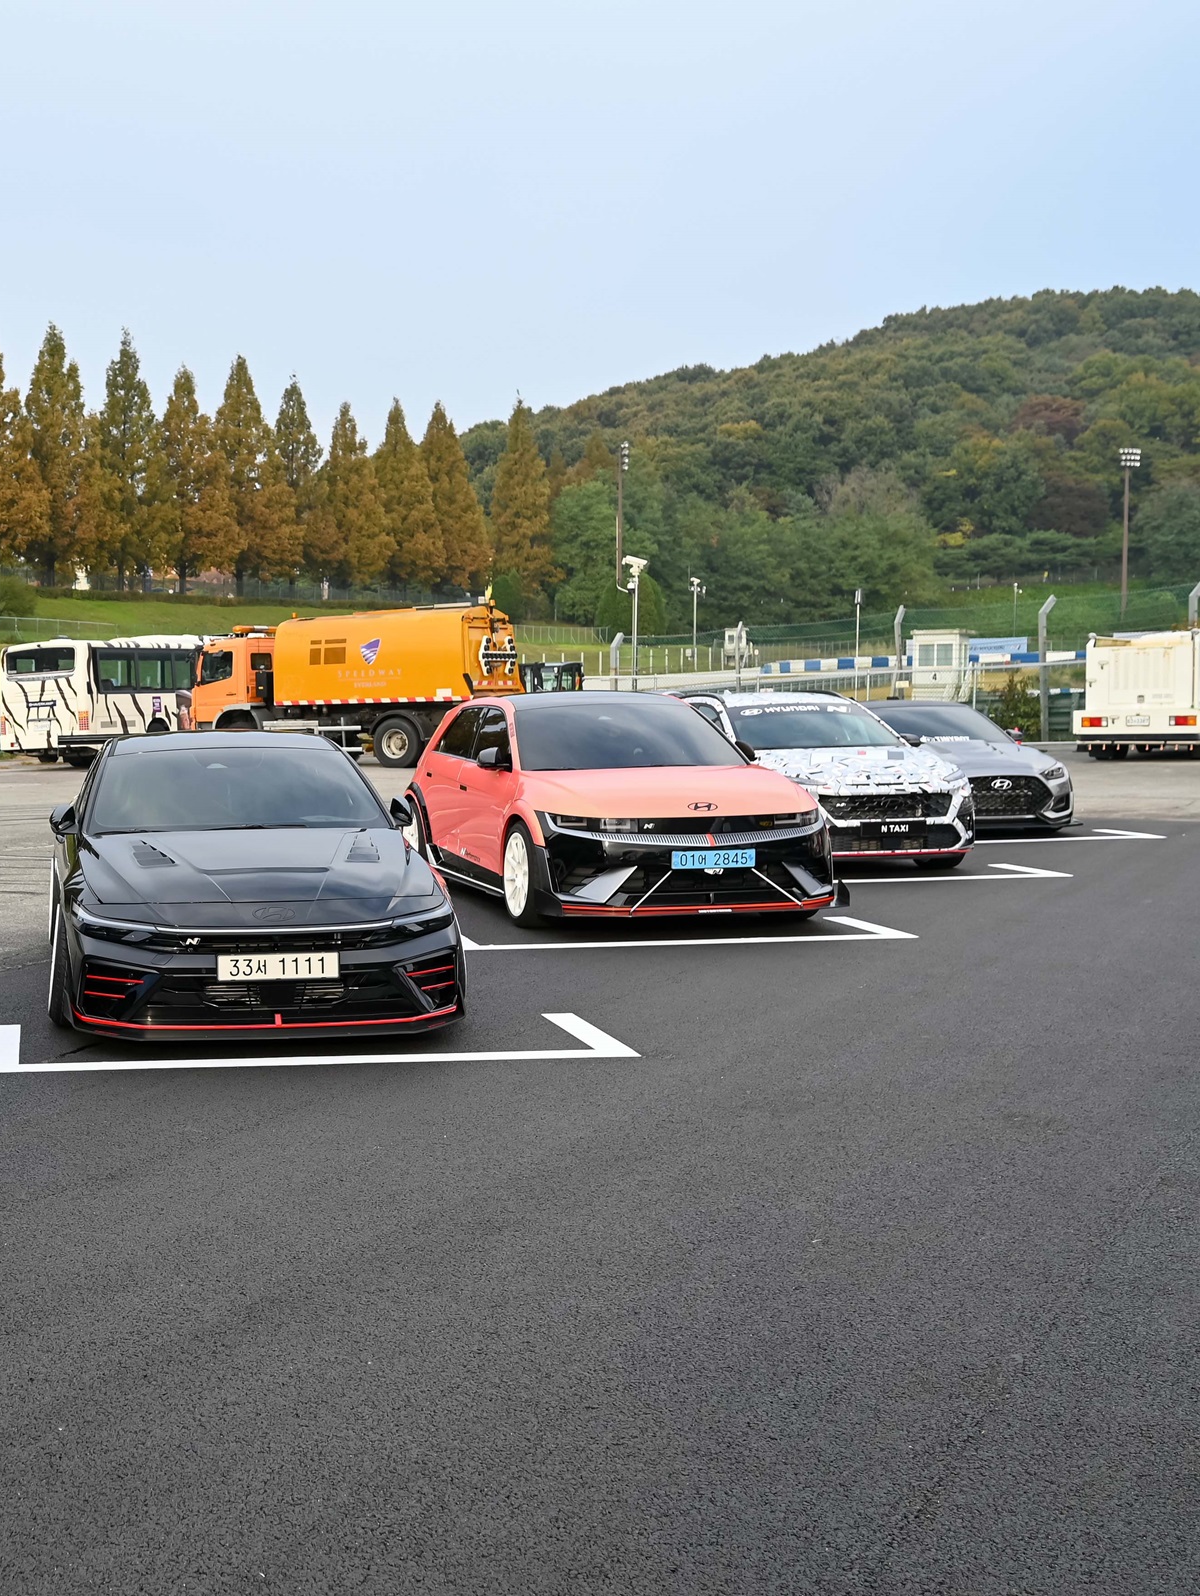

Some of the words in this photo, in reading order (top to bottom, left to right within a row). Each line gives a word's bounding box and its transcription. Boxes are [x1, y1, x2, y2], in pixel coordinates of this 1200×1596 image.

[932, 673, 937, 681] 4
[764, 705, 820, 713] HYUNDAI
[881, 825, 888, 833] N
[889, 824, 909, 833] TAXI
[680, 854, 707, 867] 01어
[714, 852, 749, 866] 2845
[229, 958, 267, 977] 33서
[278, 956, 325, 975] 1111
